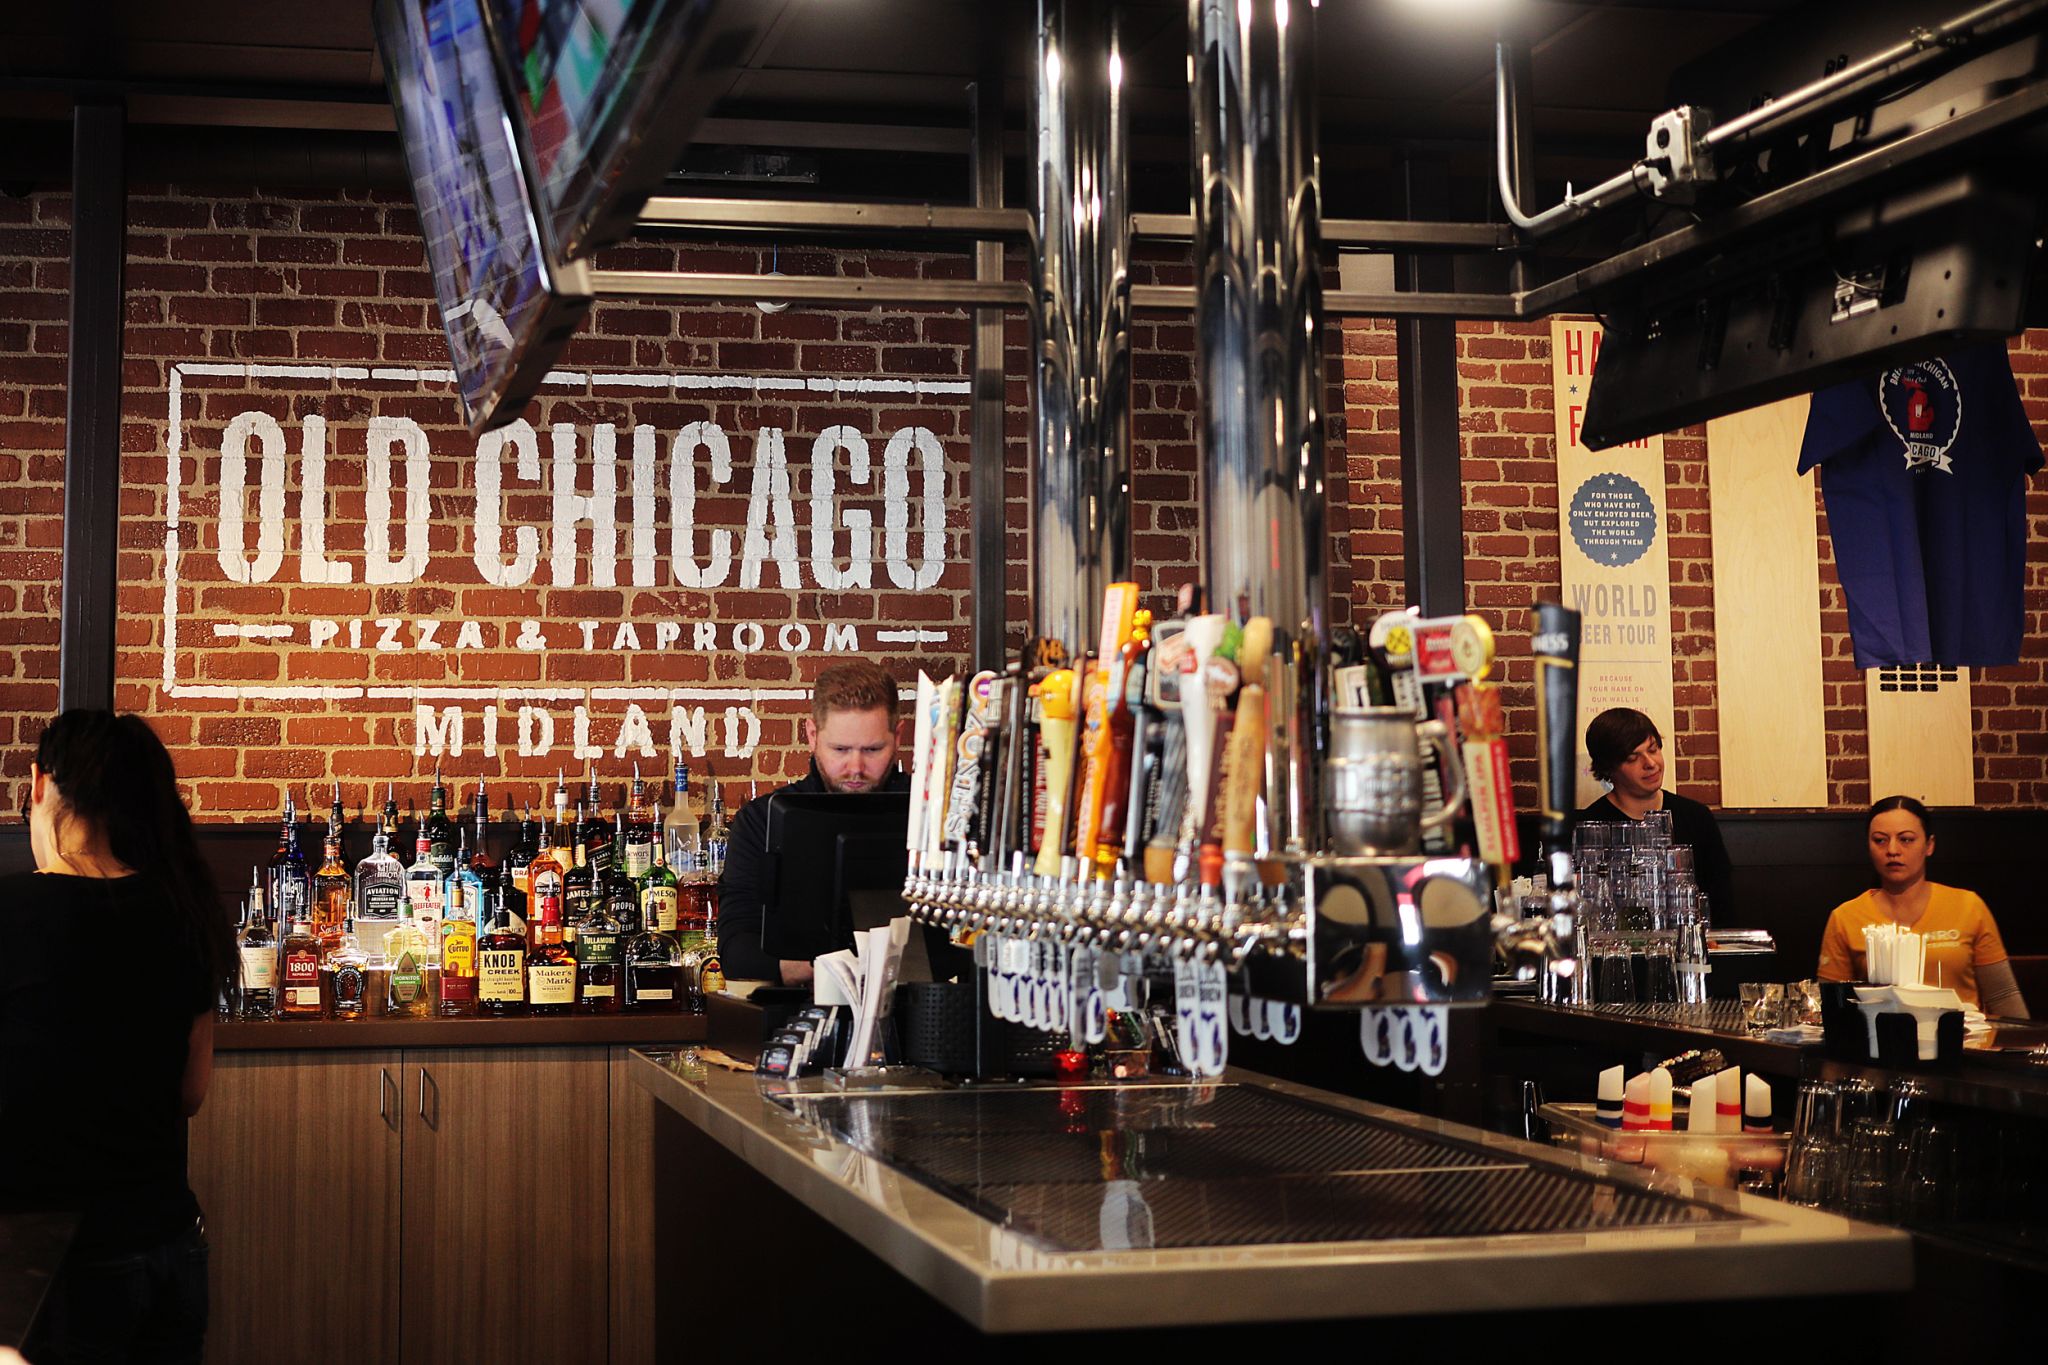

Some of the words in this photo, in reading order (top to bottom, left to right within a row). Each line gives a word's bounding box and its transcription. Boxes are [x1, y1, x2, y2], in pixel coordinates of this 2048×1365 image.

[1591, 492, 1606, 500] FOR
[1608, 492, 1633, 500] THOSE
[217, 411, 431, 585] OLD
[473, 417, 947, 592] CHICAGO
[1584, 501, 1602, 509] WHO
[1584, 538, 1620, 546] THROUGH
[1571, 583, 1657, 618] WORLD
[311, 618, 483, 653] PIZZA
[515, 619, 548, 653] &
[579, 620, 860, 654] TAPROOM
[1580, 624, 1612, 646] EER
[1617, 624, 1656, 646] TOUR
[414, 704, 762, 760] MIDLAND
[366, 887, 399, 895] AVIATION
[566, 889, 592, 900] JAMES
[644, 889, 677, 900] JMESON
[413, 902, 441, 910] BEEFEATER
[611, 901, 636, 911] PROPER
[581, 935, 617, 944] TULLAMORE
[592, 943, 607, 951] DEW
[483, 953, 516, 968] KNOB
[289, 962, 315, 973] 1800
[536, 969, 572, 977] Maker's
